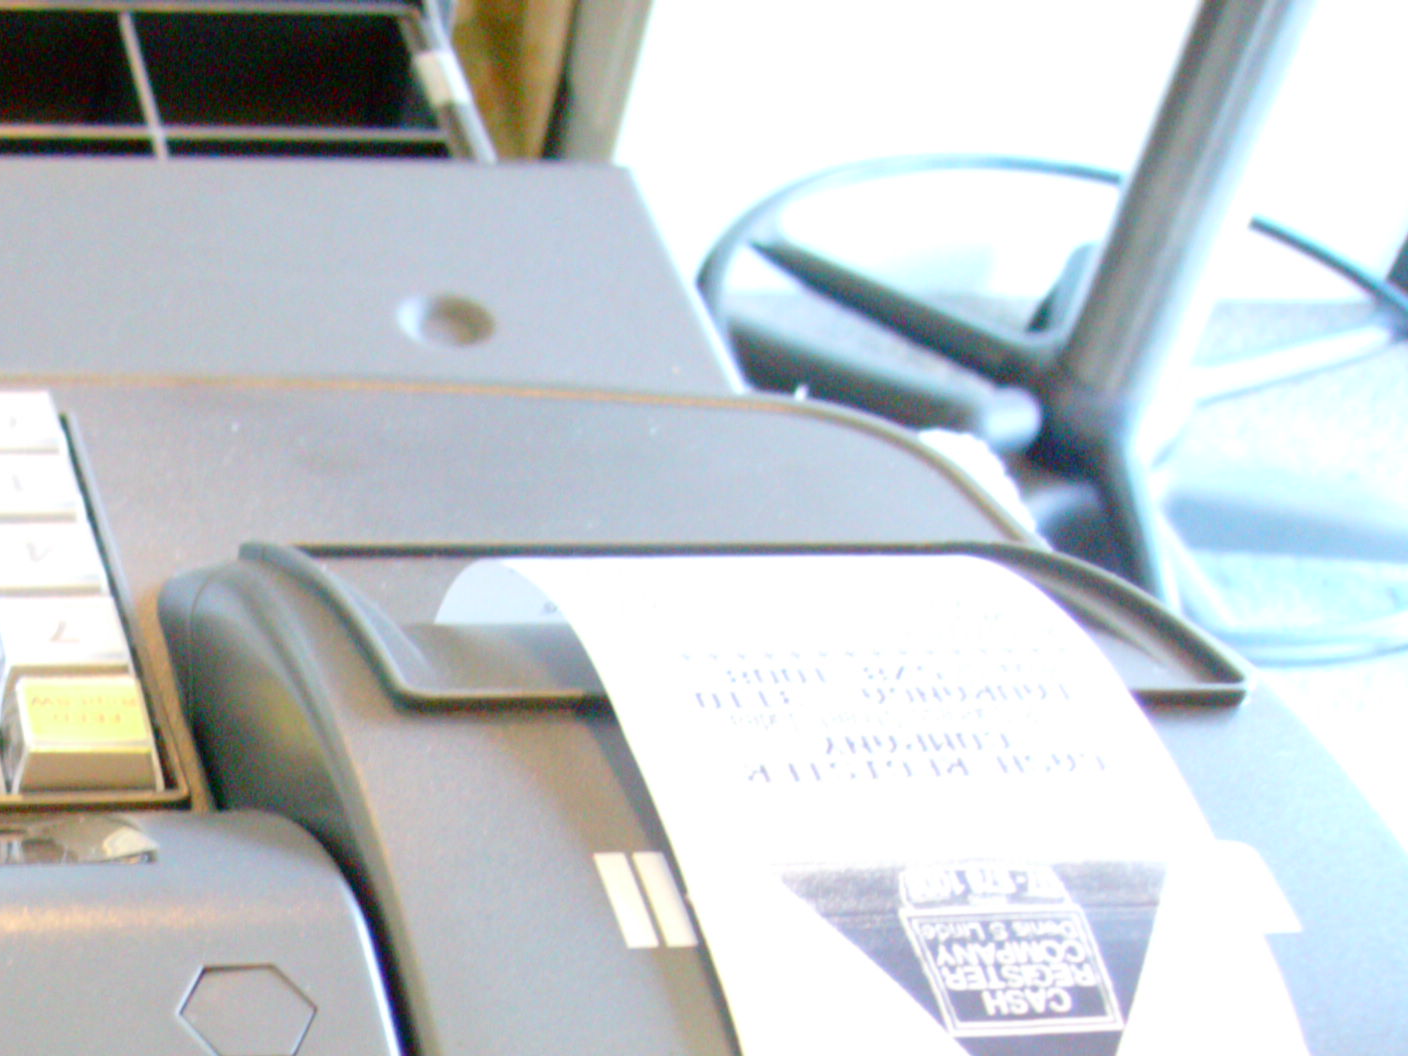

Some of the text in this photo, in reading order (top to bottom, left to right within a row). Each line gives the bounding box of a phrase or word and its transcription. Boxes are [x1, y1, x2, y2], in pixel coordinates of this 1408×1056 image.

[48, 620, 80, 643] 7
[933, 937, 1086, 968] COMPANY
[937, 963, 1097, 992] REGISTER
[981, 985, 1073, 1016] CASH
